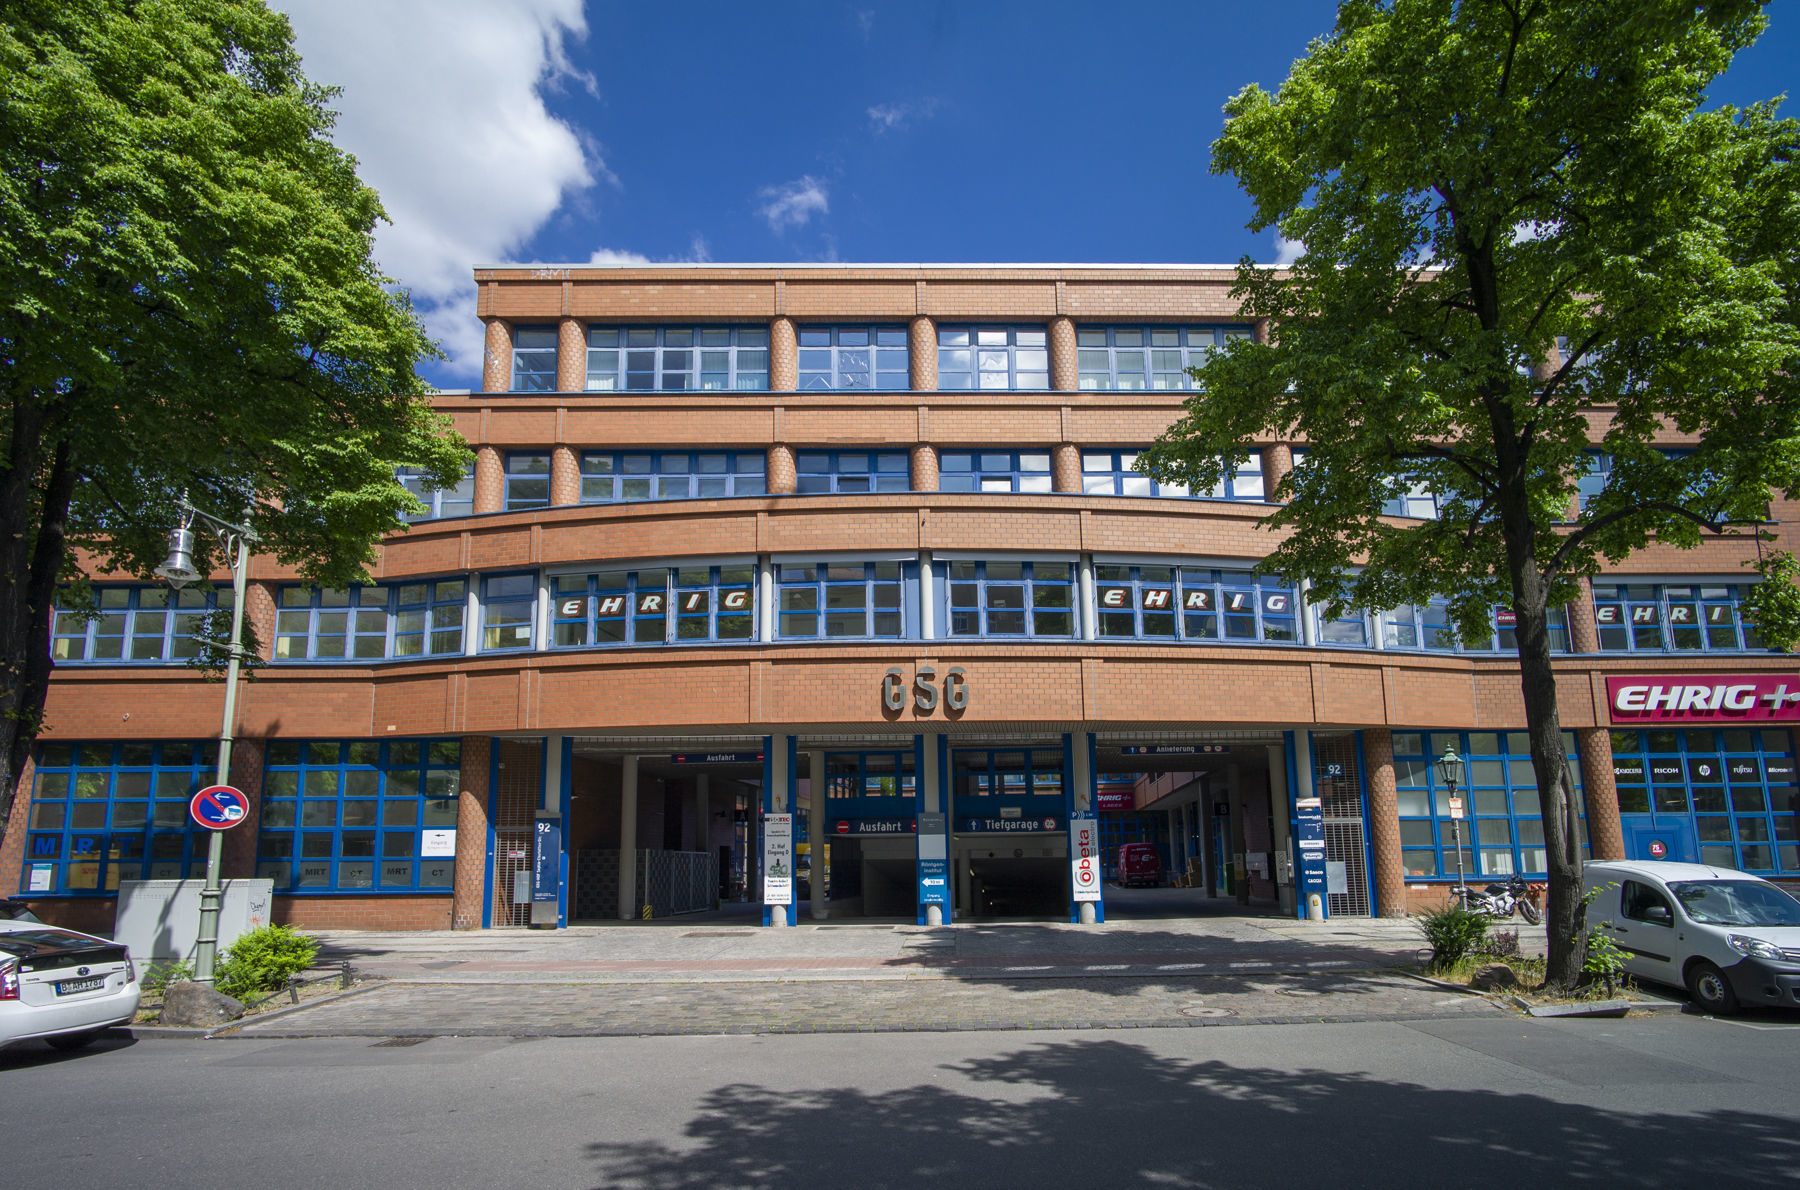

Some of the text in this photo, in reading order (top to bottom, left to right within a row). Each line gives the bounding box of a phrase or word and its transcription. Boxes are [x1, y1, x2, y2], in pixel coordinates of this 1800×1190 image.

[562, 592, 748, 617] EHRIG
[1104, 589, 1287, 612] EHRIG
[1598, 607, 1760, 622] EHRI
[884, 666, 970, 710] GSG
[1616, 685, 1757, 711] EHRIG
[1156, 745, 1195, 753] Anlieferung
[1328, 765, 1341, 775] 92
[538, 823, 550, 832] 92
[859, 821, 902, 832] Ausfahrt
[985, 819, 1038, 831] Tiefgarage
[33, 837, 136, 855] MRT
[1078, 829, 1091, 882] obeta
[305, 868, 326, 876] MRT
